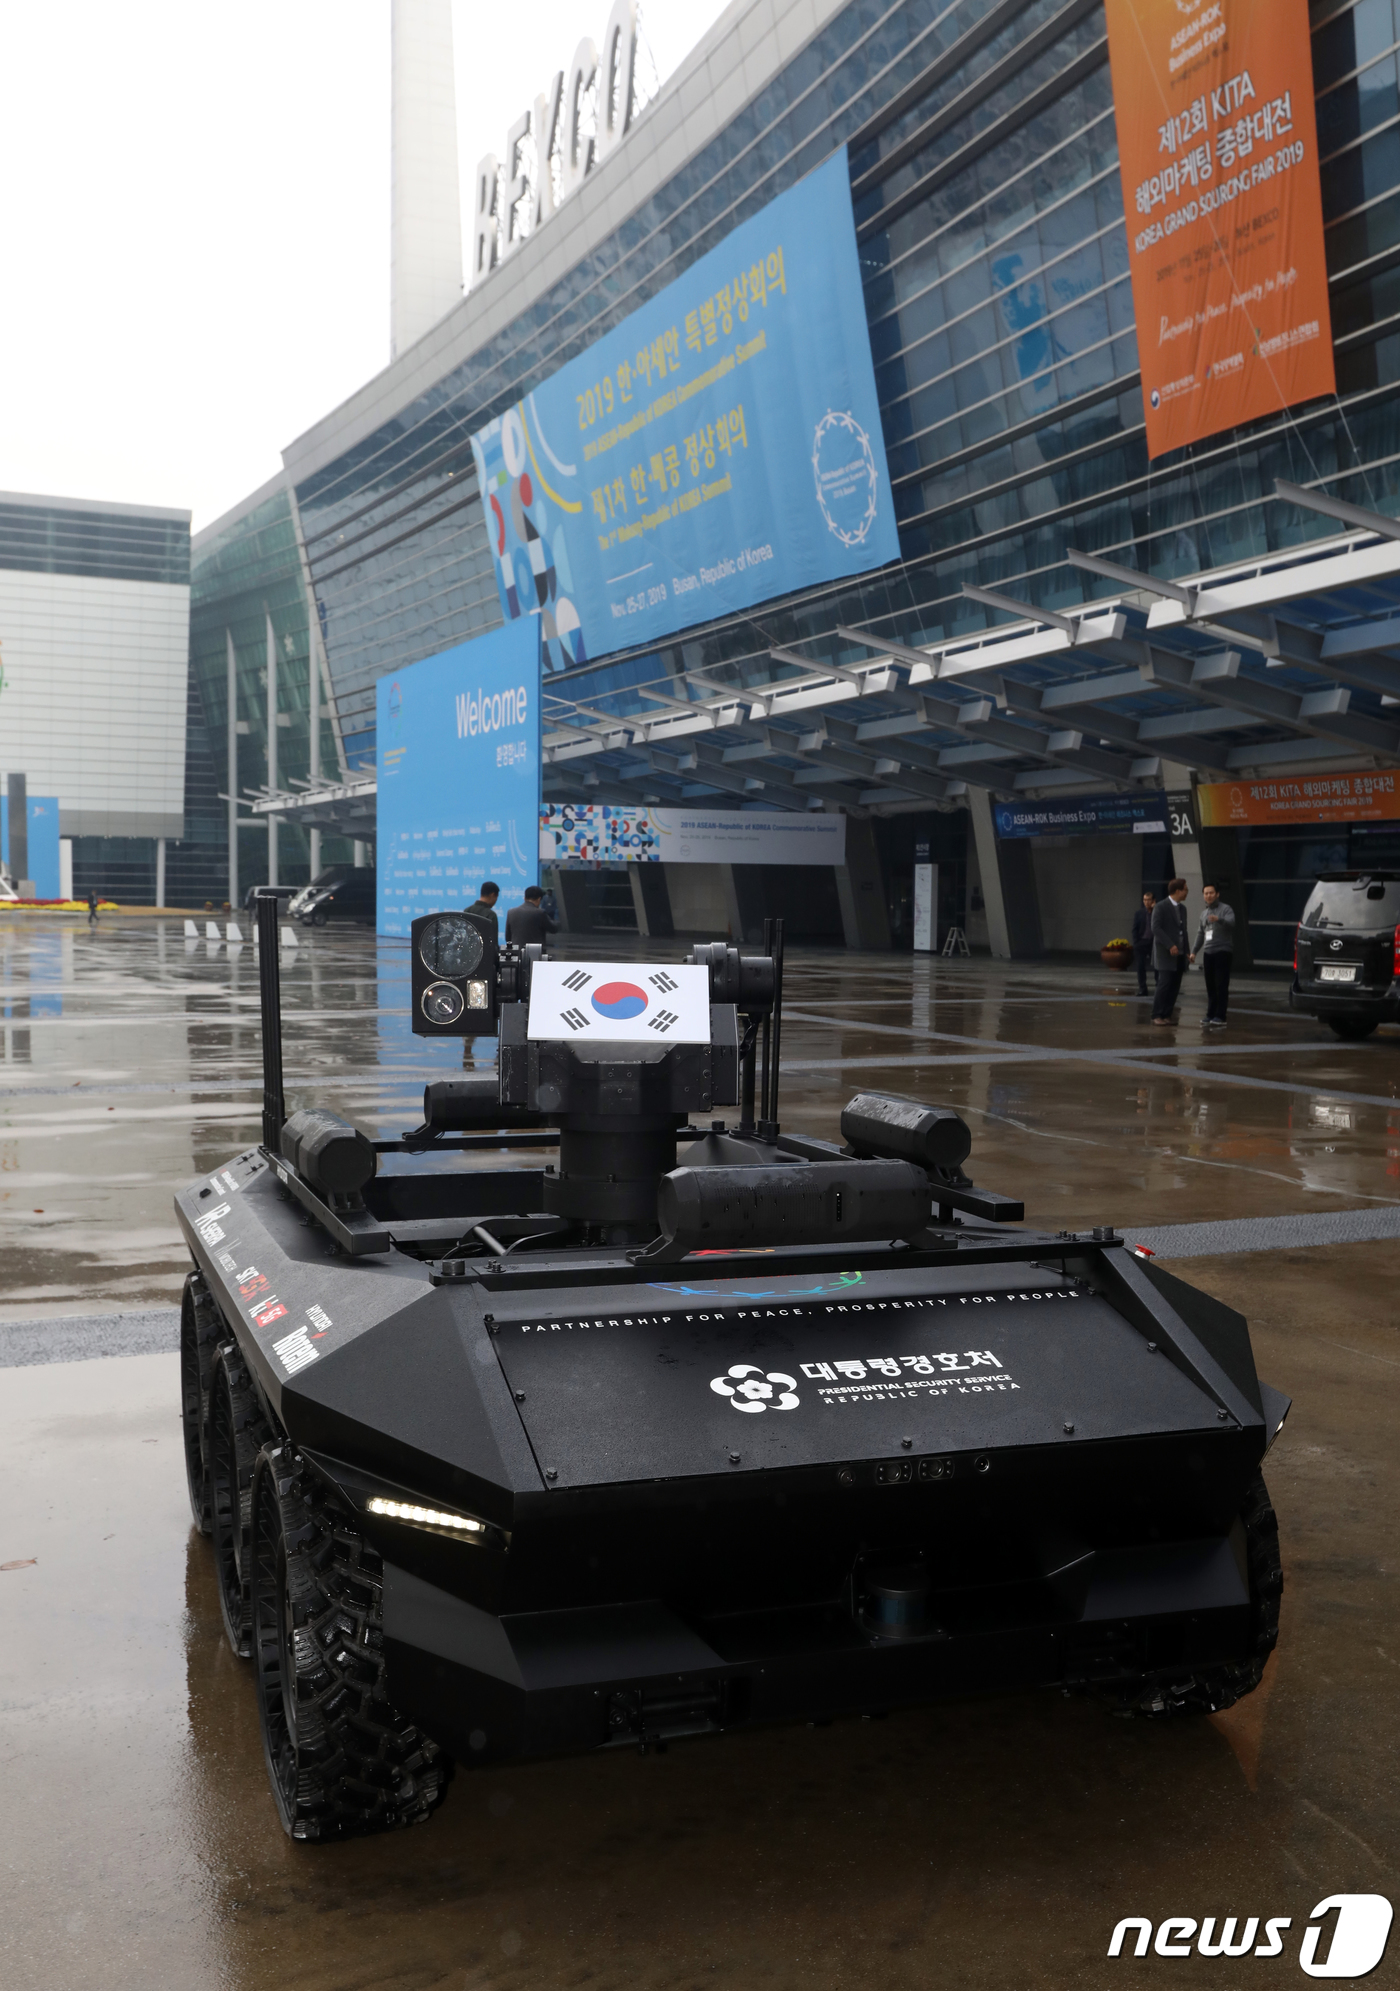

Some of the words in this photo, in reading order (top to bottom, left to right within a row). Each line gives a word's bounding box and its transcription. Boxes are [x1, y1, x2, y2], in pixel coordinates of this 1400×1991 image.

[1157, 95, 1208, 154] 제12회
[1211, 70, 1256, 122] KITA
[1135, 140, 1213, 215] 해외마케팅
[1215, 90, 1293, 168] 종합대전
[1134, 220, 1165, 255] KOREA
[1164, 200, 1199, 236] GRAND
[1199, 167, 1251, 217] SOURCING
[1251, 157, 1276, 188] FAIR
[1276, 140, 1305, 174] 2019
[576, 376, 615, 430] 2019
[685, 245, 788, 353] 특별정상회의
[591, 476, 628, 524] 제1차
[683, 404, 748, 477] 정상회의
[648, 583, 667, 606] 2019
[672, 574, 700, 596] Busan,
[700, 557, 736, 586] Republic
[737, 551, 747, 571] of
[746, 543, 774, 567] Korea
[456, 686, 527, 739] Welcome
[1250, 784, 1278, 801] 제12회
[1279, 784, 1301, 798] KITA
[1303, 779, 1350, 798] 해외마케팅
[1353, 775, 1395, 794] 종합대전
[1270, 801, 1290, 810] KOREA
[1291, 800, 1311, 809] GRAND
[1312, 798, 1343, 808] SOURCING
[1343, 797, 1357, 806] FAIR
[1358, 795, 1373, 806] 2019
[681, 821, 696, 829] 2019
[696, 822, 743, 831] ASEAN-Republic
[1013, 812, 1049, 826] ASEAN-ROK
[1049, 810, 1079, 823] Business
[1079, 810, 1096, 823] Expo
[1170, 813, 1194, 836] 3A
[260, 1306, 282, 1324] 5G
[305, 1303, 334, 1332] HYUNDAI
[521, 1316, 672, 1333] PARTNERSHIP
[685, 1313, 725, 1323] FOR
[825, 1298, 948, 1313] PROSPERITY
[959, 1296, 997, 1305] FOR
[1006, 1290, 1080, 1302] PEOPLE
[799, 1350, 1004, 1381] 대통령경호처
[817, 1382, 905, 1396] PRESIDENTIAL
[904, 1377, 962, 1389] SECURITY
[963, 1374, 1013, 1385] SERVICE
[823, 1390, 919, 1405] REPUBLIC
[928, 1388, 950, 1396] OF
[958, 1382, 1022, 1394] KOREA
